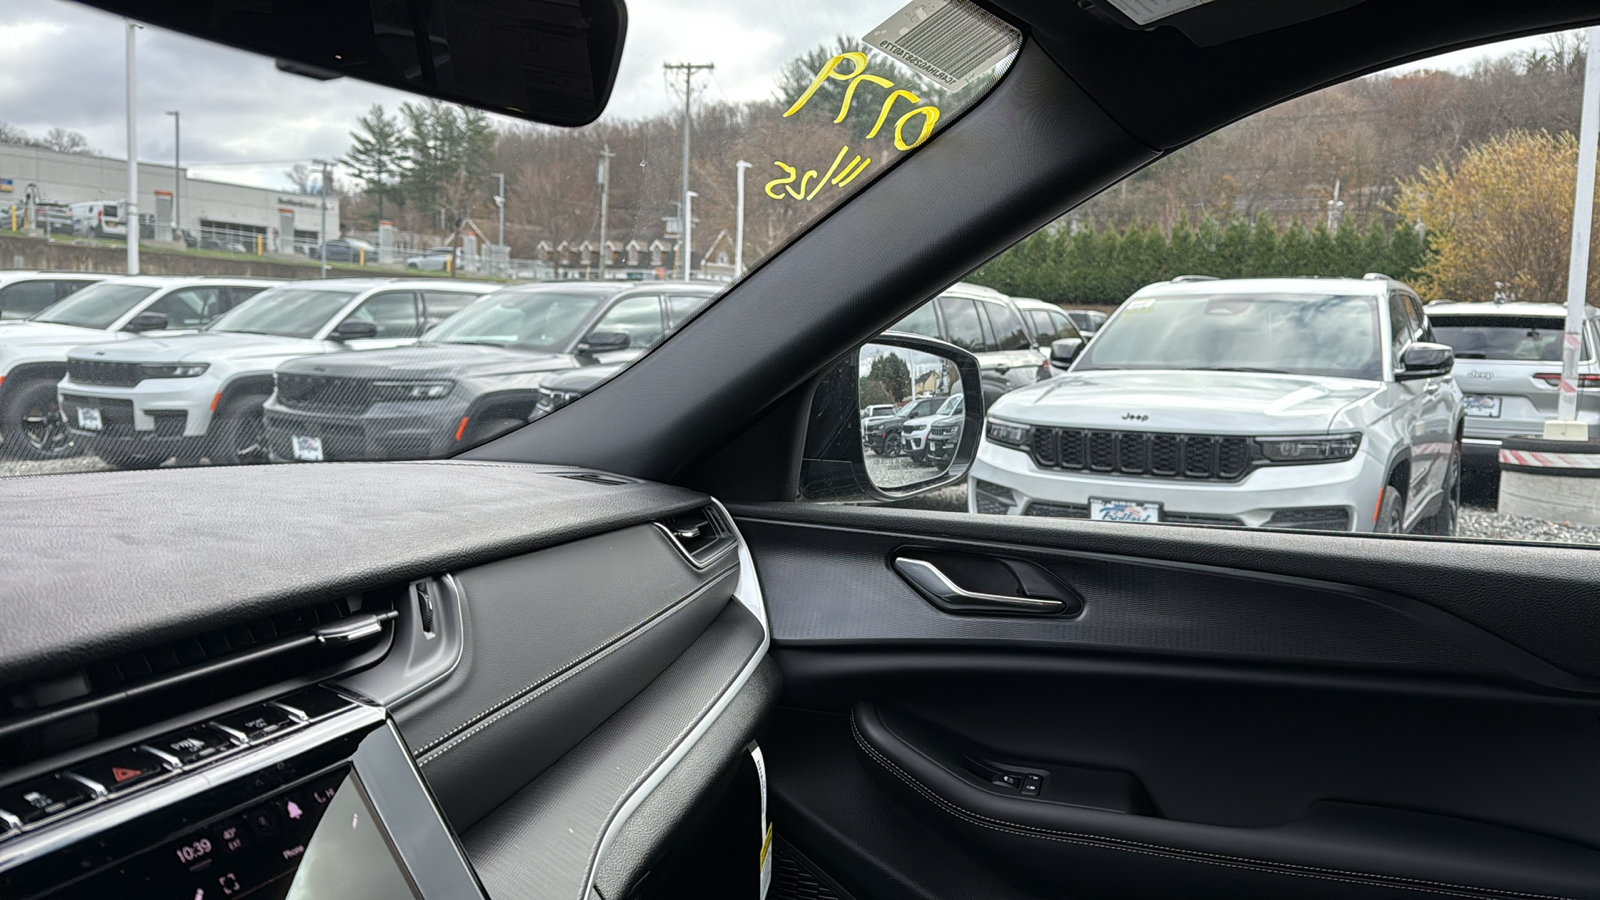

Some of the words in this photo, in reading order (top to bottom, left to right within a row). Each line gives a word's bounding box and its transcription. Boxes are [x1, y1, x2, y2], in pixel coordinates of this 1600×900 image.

[1468, 369, 1494, 380] Jeep
[1121, 412, 1149, 422] Jeep
[176, 838, 212, 864] 10:39
[282, 845, 304, 860] Phone
